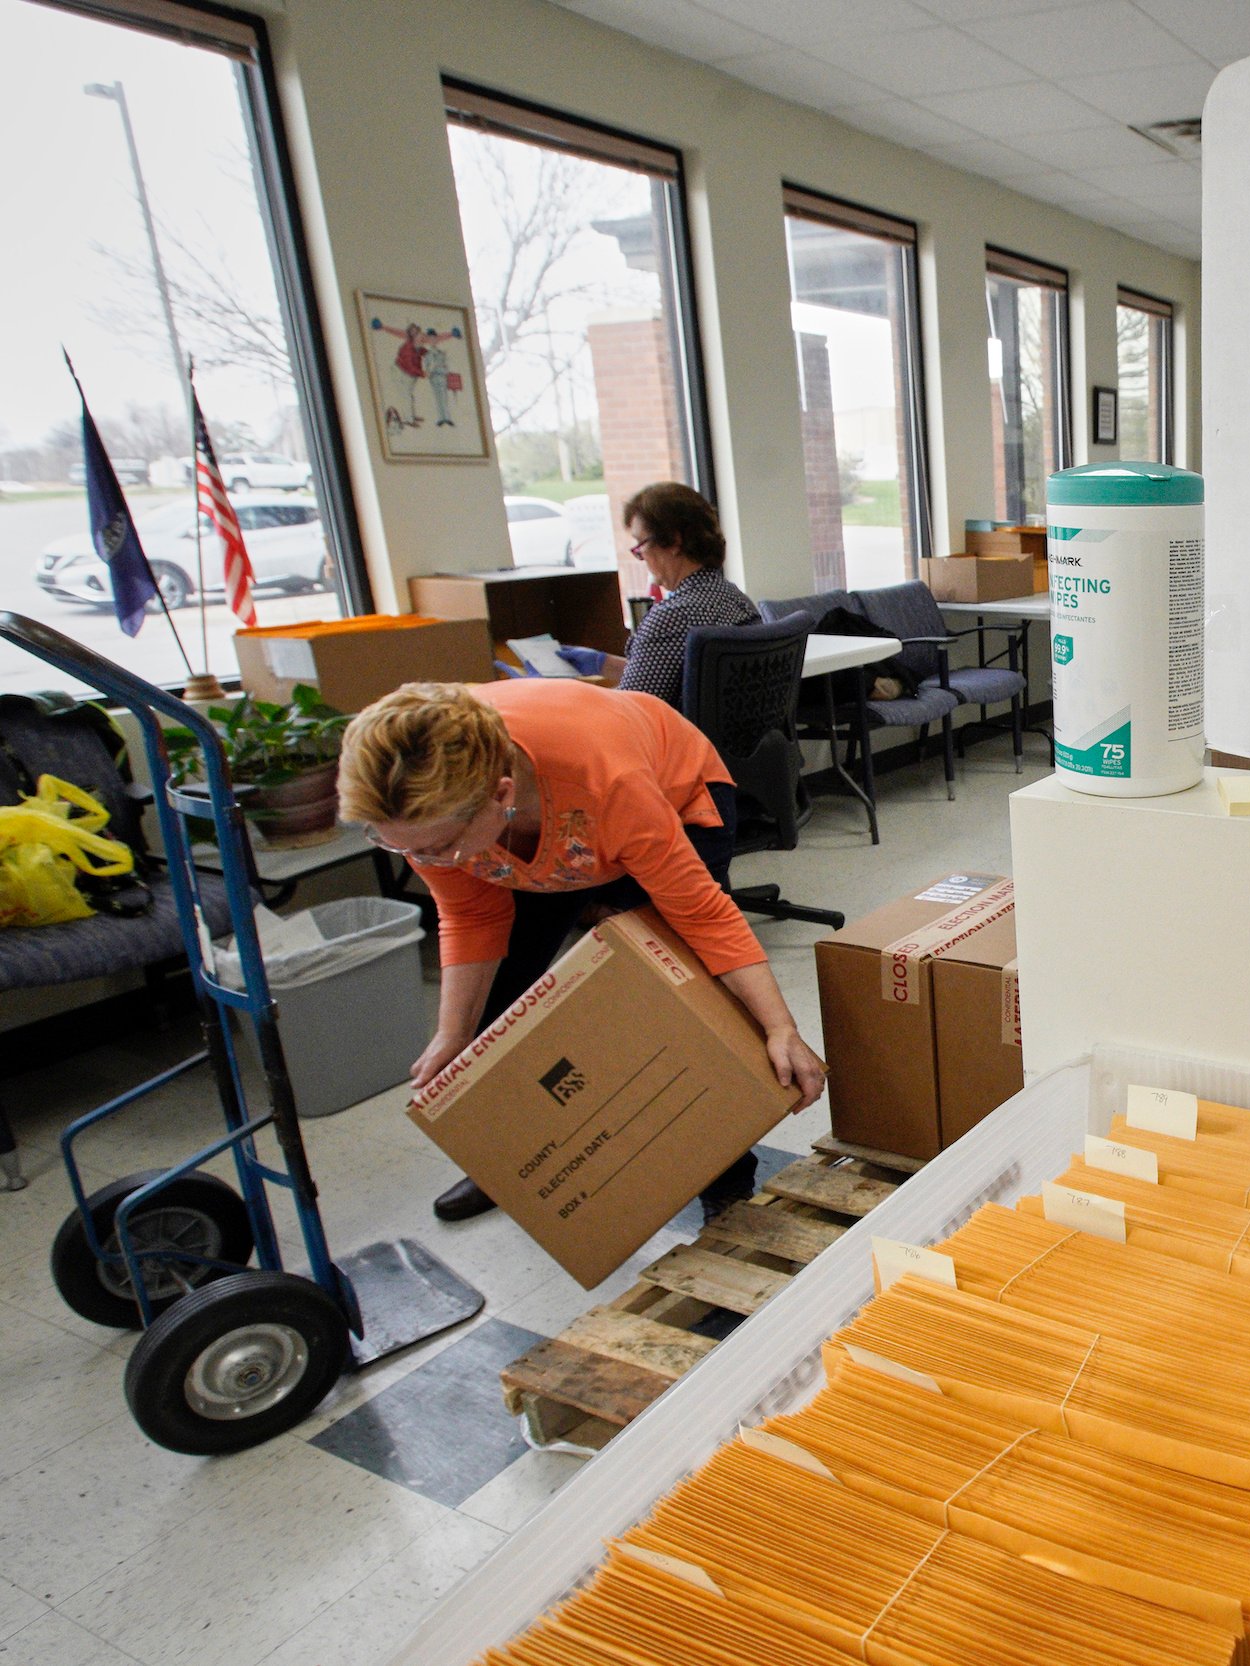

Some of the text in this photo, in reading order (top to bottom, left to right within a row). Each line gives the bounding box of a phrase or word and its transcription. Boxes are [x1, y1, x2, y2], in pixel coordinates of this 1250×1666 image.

[1100, 743, 1125, 759] 75
[938, 901, 989, 931] ELECTION
[893, 943, 919, 1002] CLOSED
[518, 1140, 557, 1179] COUNTY
[538, 1129, 612, 1199] ELECTION DATE
[558, 1197, 582, 1219] BOX
